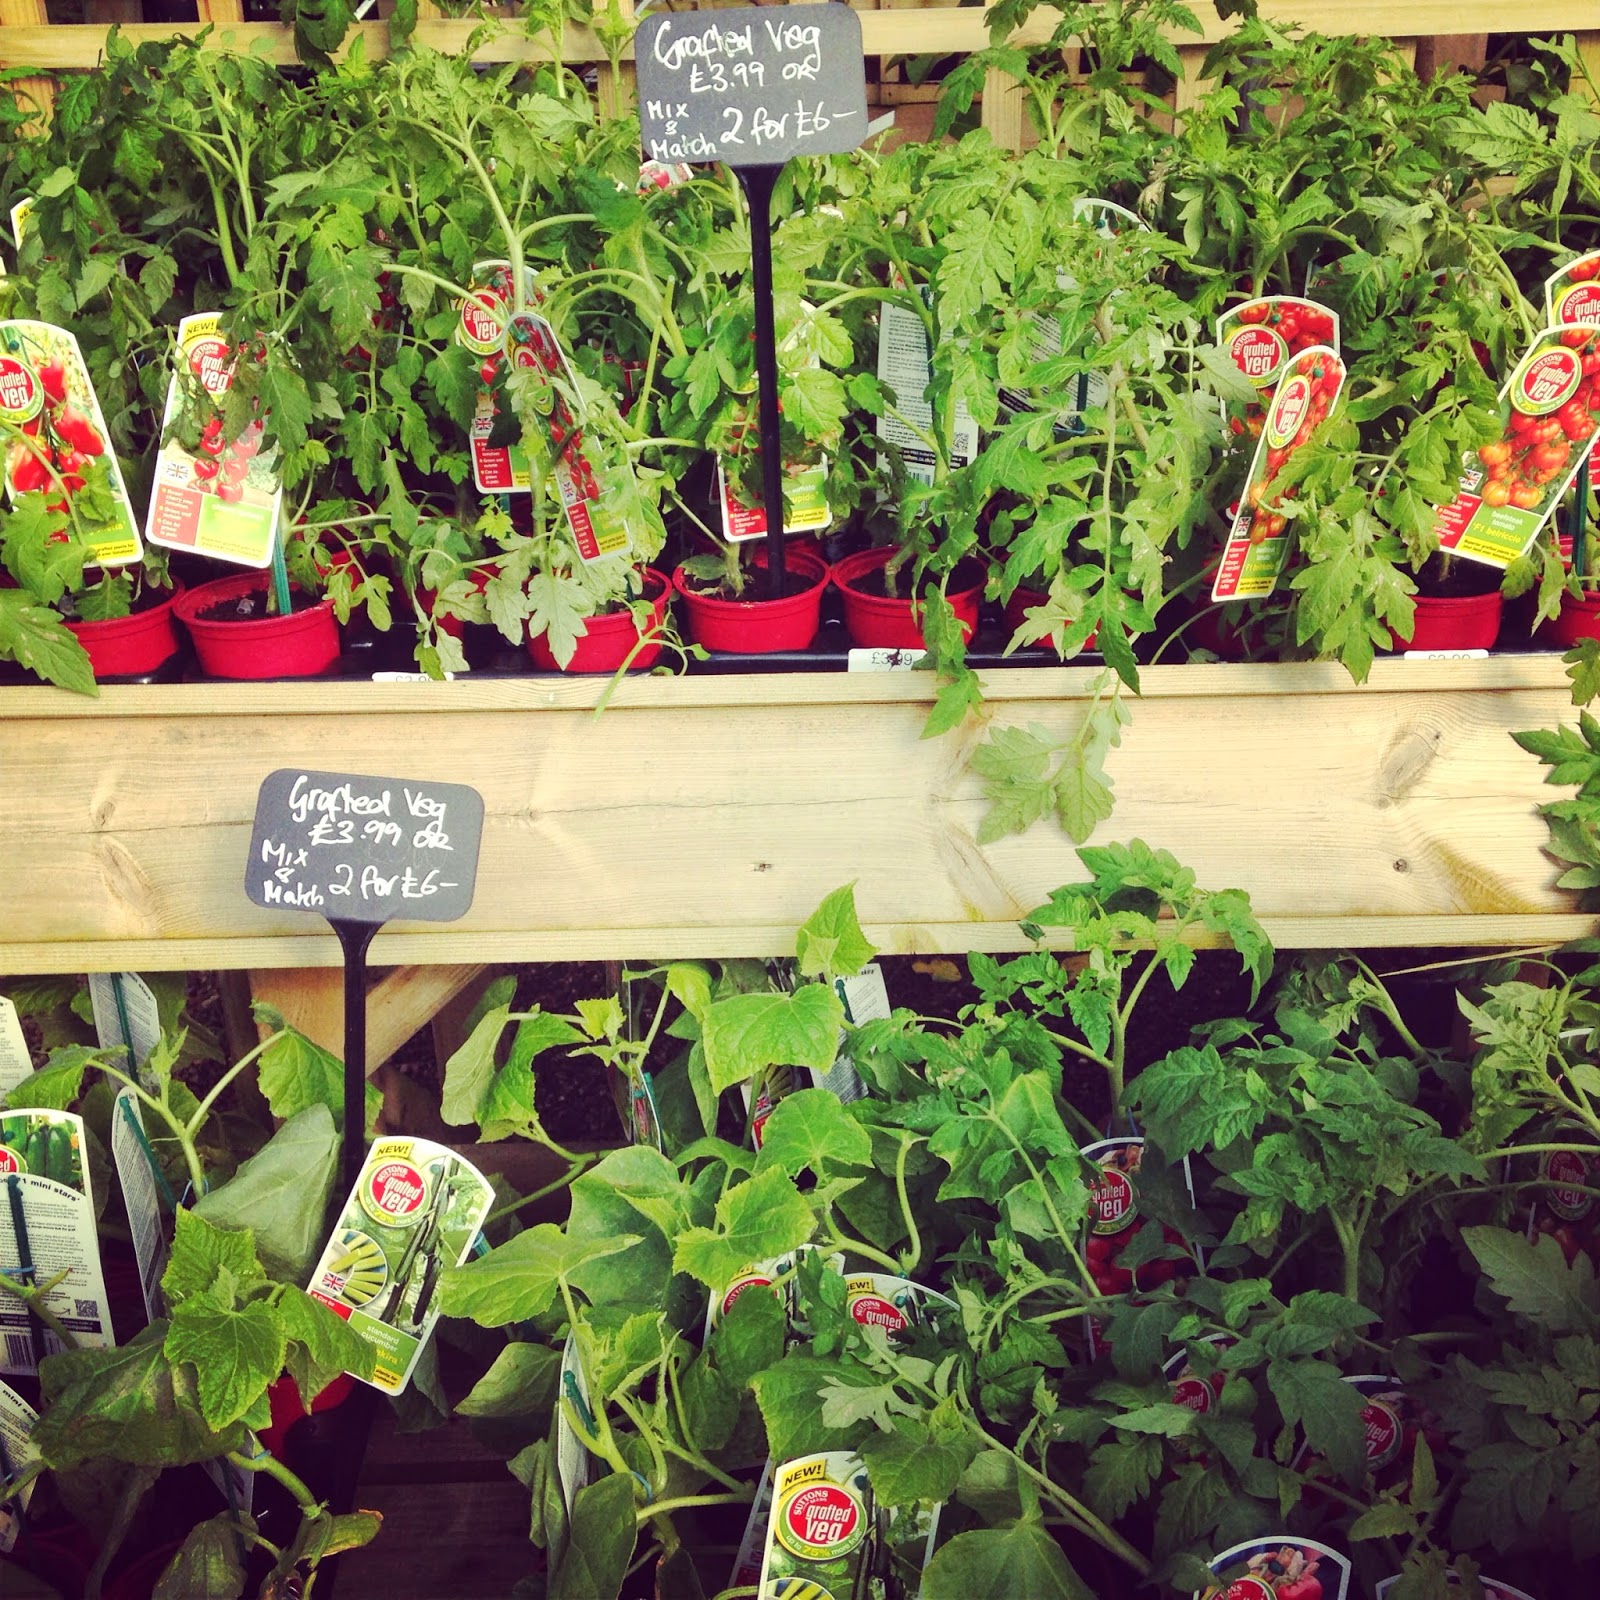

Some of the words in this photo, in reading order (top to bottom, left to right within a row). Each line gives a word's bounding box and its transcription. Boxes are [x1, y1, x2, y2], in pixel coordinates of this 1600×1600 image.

[654, 20, 754, 70] Grafted
[764, 20, 821, 72] Veg
[690, 62, 764, 93] £3.99
[720, 107, 744, 144] 2
[750, 107, 789, 145] for
[651, 133, 717, 160] Match
[186, 321, 215, 336] NEW!
[473, 319, 497, 340] veg
[1233, 331, 1257, 355] SUTTONS
[1243, 342, 1275, 358] grafted
[1245, 355, 1272, 375] veg
[1531, 354, 1564, 374] SUTTONS
[201, 368, 230, 391] veg
[1537, 366, 1572, 385] grafted
[0, 386, 29, 408] veg
[1528, 377, 1560, 401] veg
[1491, 510, 1523, 525] beefsteak
[1492, 519, 1516, 530] tomato
[871, 652, 912, 666] £399
[289, 775, 391, 822] Grafted
[403, 788, 447, 834] Veg
[308, 814, 402, 846] £3.99
[328, 864, 353, 896] 2
[360, 865, 401, 900] for
[263, 880, 324, 907] Match
[377, 1145, 409, 1156] NEW!
[376, 1164, 408, 1183] SUTTONS
[31, 1180, 51, 1190] mini
[384, 1176, 422, 1201] grafted
[380, 1187, 412, 1214] veg
[856, 1300, 880, 1316] SUTTONS
[866, 1311, 902, 1330] grafted
[361, 1331, 398, 1352] cucumber
[367, 1325, 400, 1345] standard
[784, 1464, 822, 1486] NEW!
[793, 1490, 829, 1516] SUTTONS
[805, 1504, 852, 1523] grafted
[805, 1518, 844, 1544] veg
[786, 1535, 794, 1545] up
[794, 1541, 801, 1549] to
[803, 1545, 831, 1557] 75%
[831, 1544, 850, 1556] more
